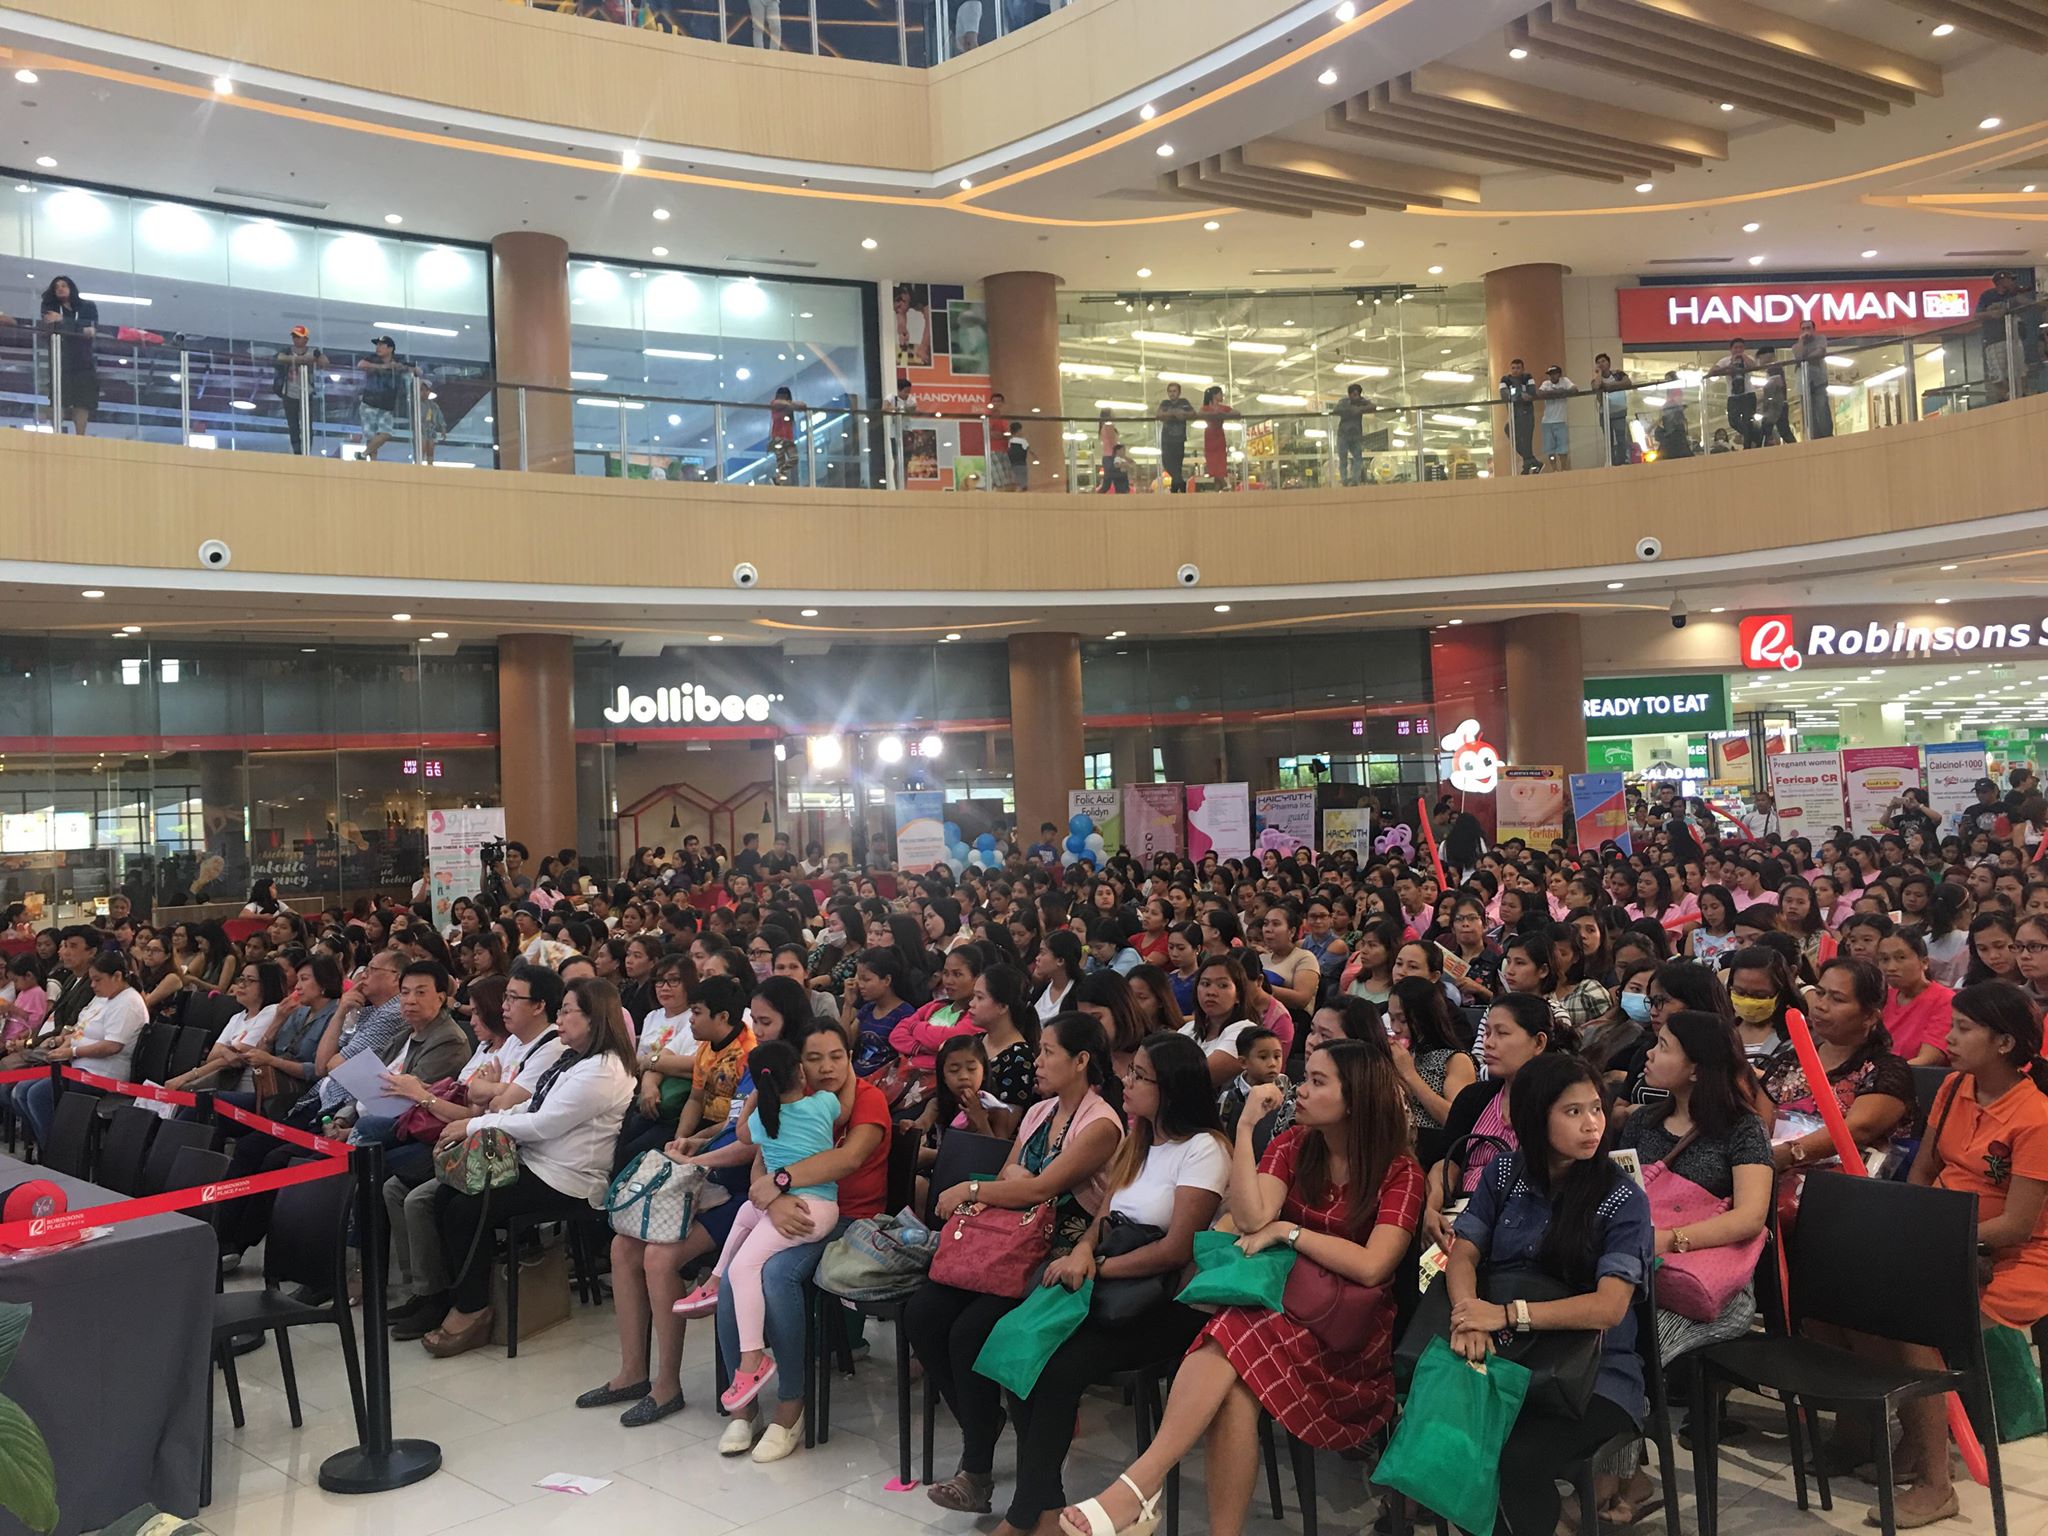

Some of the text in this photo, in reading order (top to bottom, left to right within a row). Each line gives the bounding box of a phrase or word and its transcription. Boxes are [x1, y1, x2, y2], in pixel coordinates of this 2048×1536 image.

[1668, 291, 1917, 325] HANDYMAN
[914, 392, 986, 404] HANDYMAN
[1808, 622, 2031, 656] Robinsons
[604, 682, 771, 724] Jollibee
[1583, 693, 1710, 717] READY TO EAT
[1773, 761, 1807, 769] Pregnant
[1929, 759, 1983, 771] Calcinol-1000
[1640, 767, 1684, 780] SALAD
[1775, 773, 1838, 785] Fericap CR
[1075, 793, 1114, 805] Folic Acid
[1081, 807, 1109, 818] Folidyn
[216, 1180, 250, 1191] ROBINSONS
[216, 1188, 234, 1196] PLACE
[46, 1212, 84, 1225] ROBINSONS
[46, 1221, 66, 1231] PLACE
